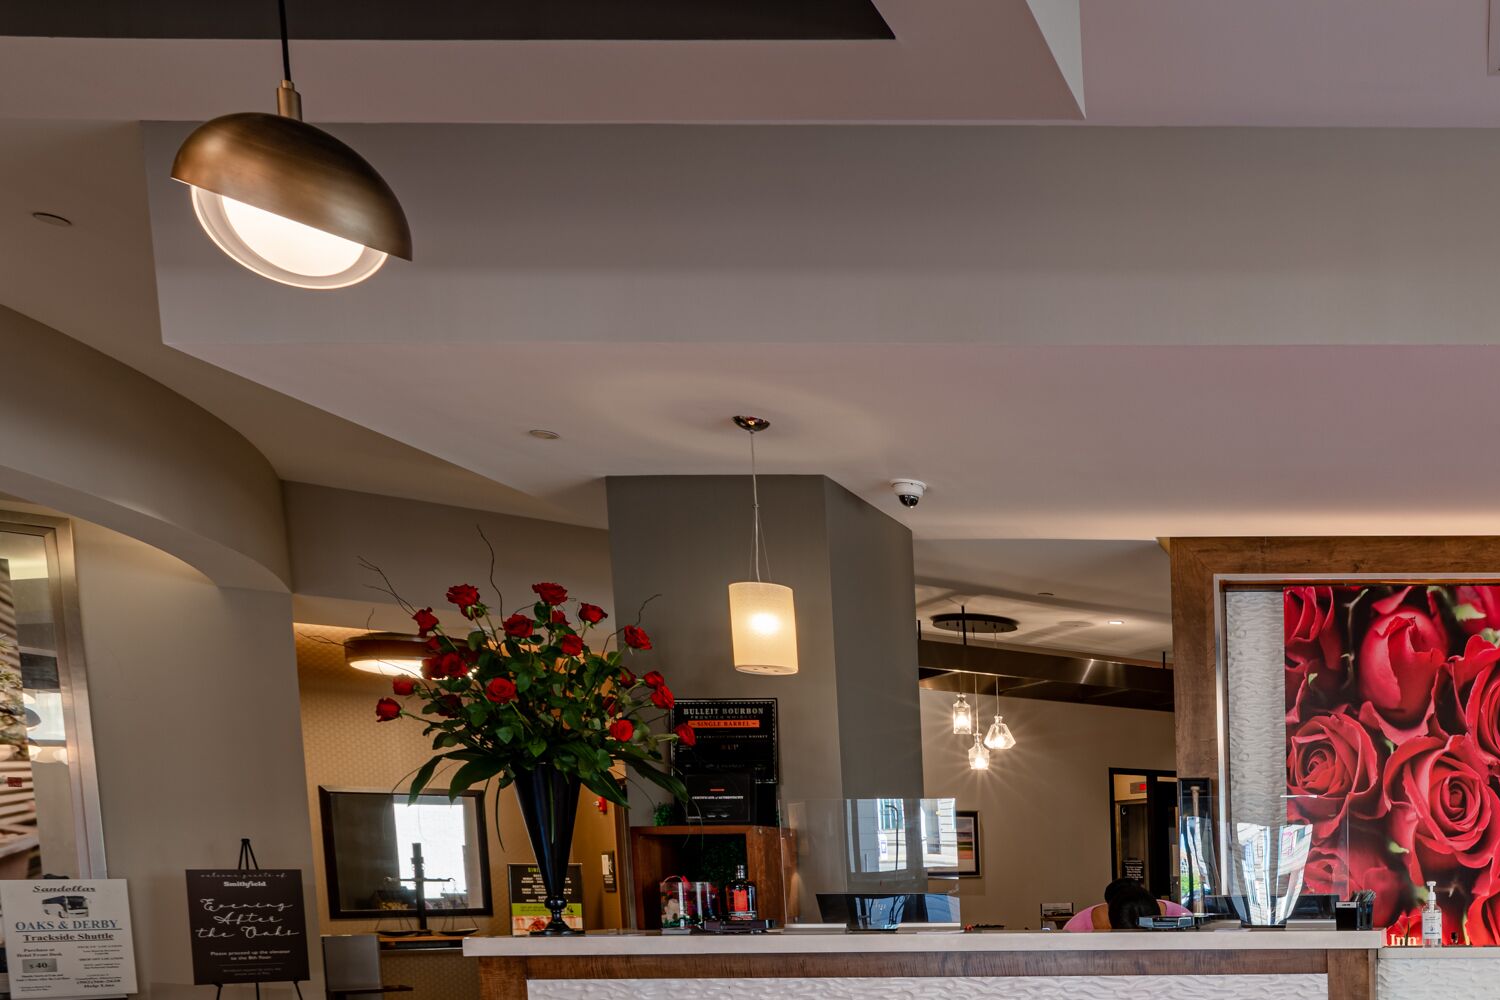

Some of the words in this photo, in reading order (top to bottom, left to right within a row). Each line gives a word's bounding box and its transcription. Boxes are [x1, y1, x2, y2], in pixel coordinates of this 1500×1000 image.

[722, 707, 764, 715] BOURBON
[223, 880, 267, 889] Smithfield
[200, 897, 294, 912] Evening
[213, 911, 284, 925] After
[15, 920, 54, 931] OAKS
[58, 920, 68, 930] &
[73, 919, 118, 929] DERBY
[24, 933, 74, 942] Trackside
[78, 932, 114, 941] Shuttle
[195, 927, 236, 938] the
[240, 925, 300, 939] Oaks
[1390, 933, 1418, 946] Inn
